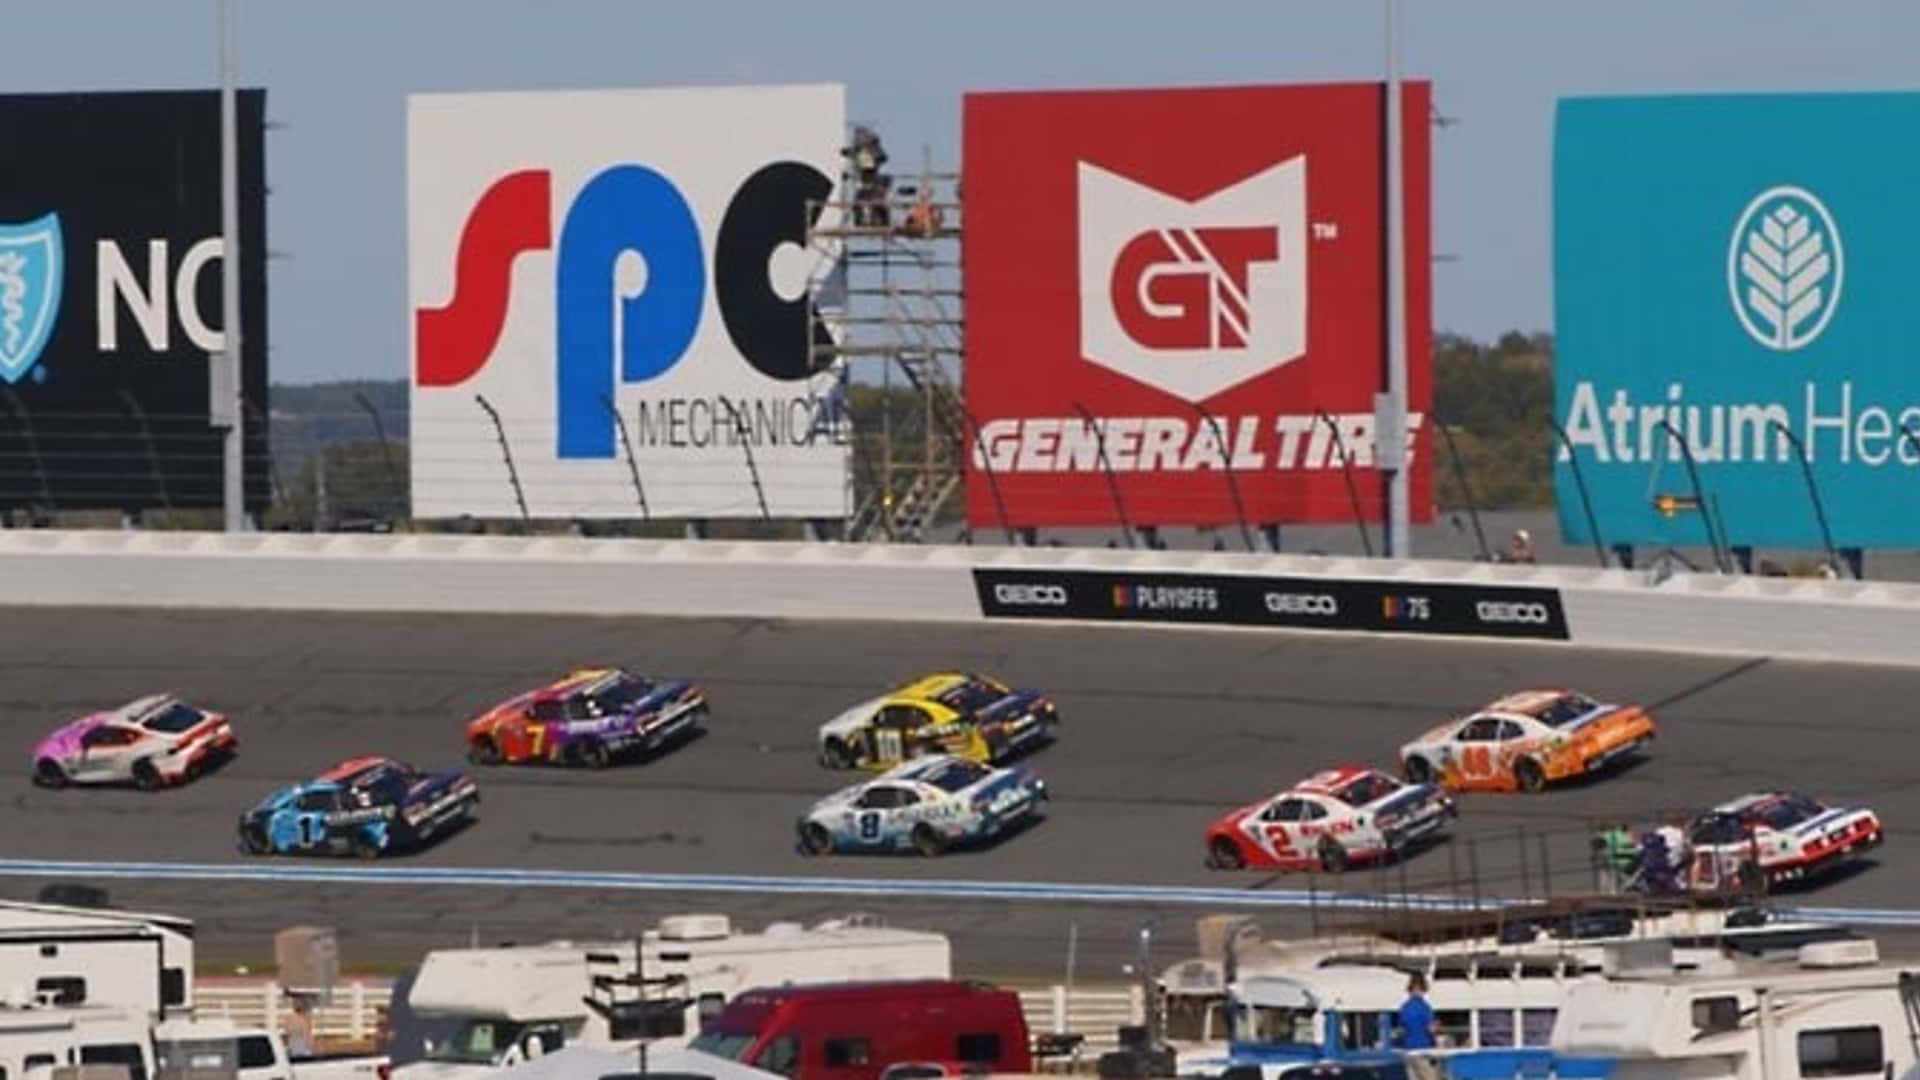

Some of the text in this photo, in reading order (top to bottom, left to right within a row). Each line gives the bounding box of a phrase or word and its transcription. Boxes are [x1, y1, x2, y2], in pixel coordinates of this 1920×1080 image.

[1110, 226, 1279, 349] GT
[1557, 381, 1789, 463] Atrium
[973, 415, 1264, 472] GENERAL
[995, 584, 1067, 605] GEICO
[1136, 586, 1219, 611] PLAYOFFS
[1264, 593, 1338, 615] GEICO
[1476, 601, 1549, 624] GEICO
[526, 724, 546, 756] 7
[299, 816, 313, 844] 1
[860, 811, 880, 839] 8
[1264, 824, 1298, 858] 2
